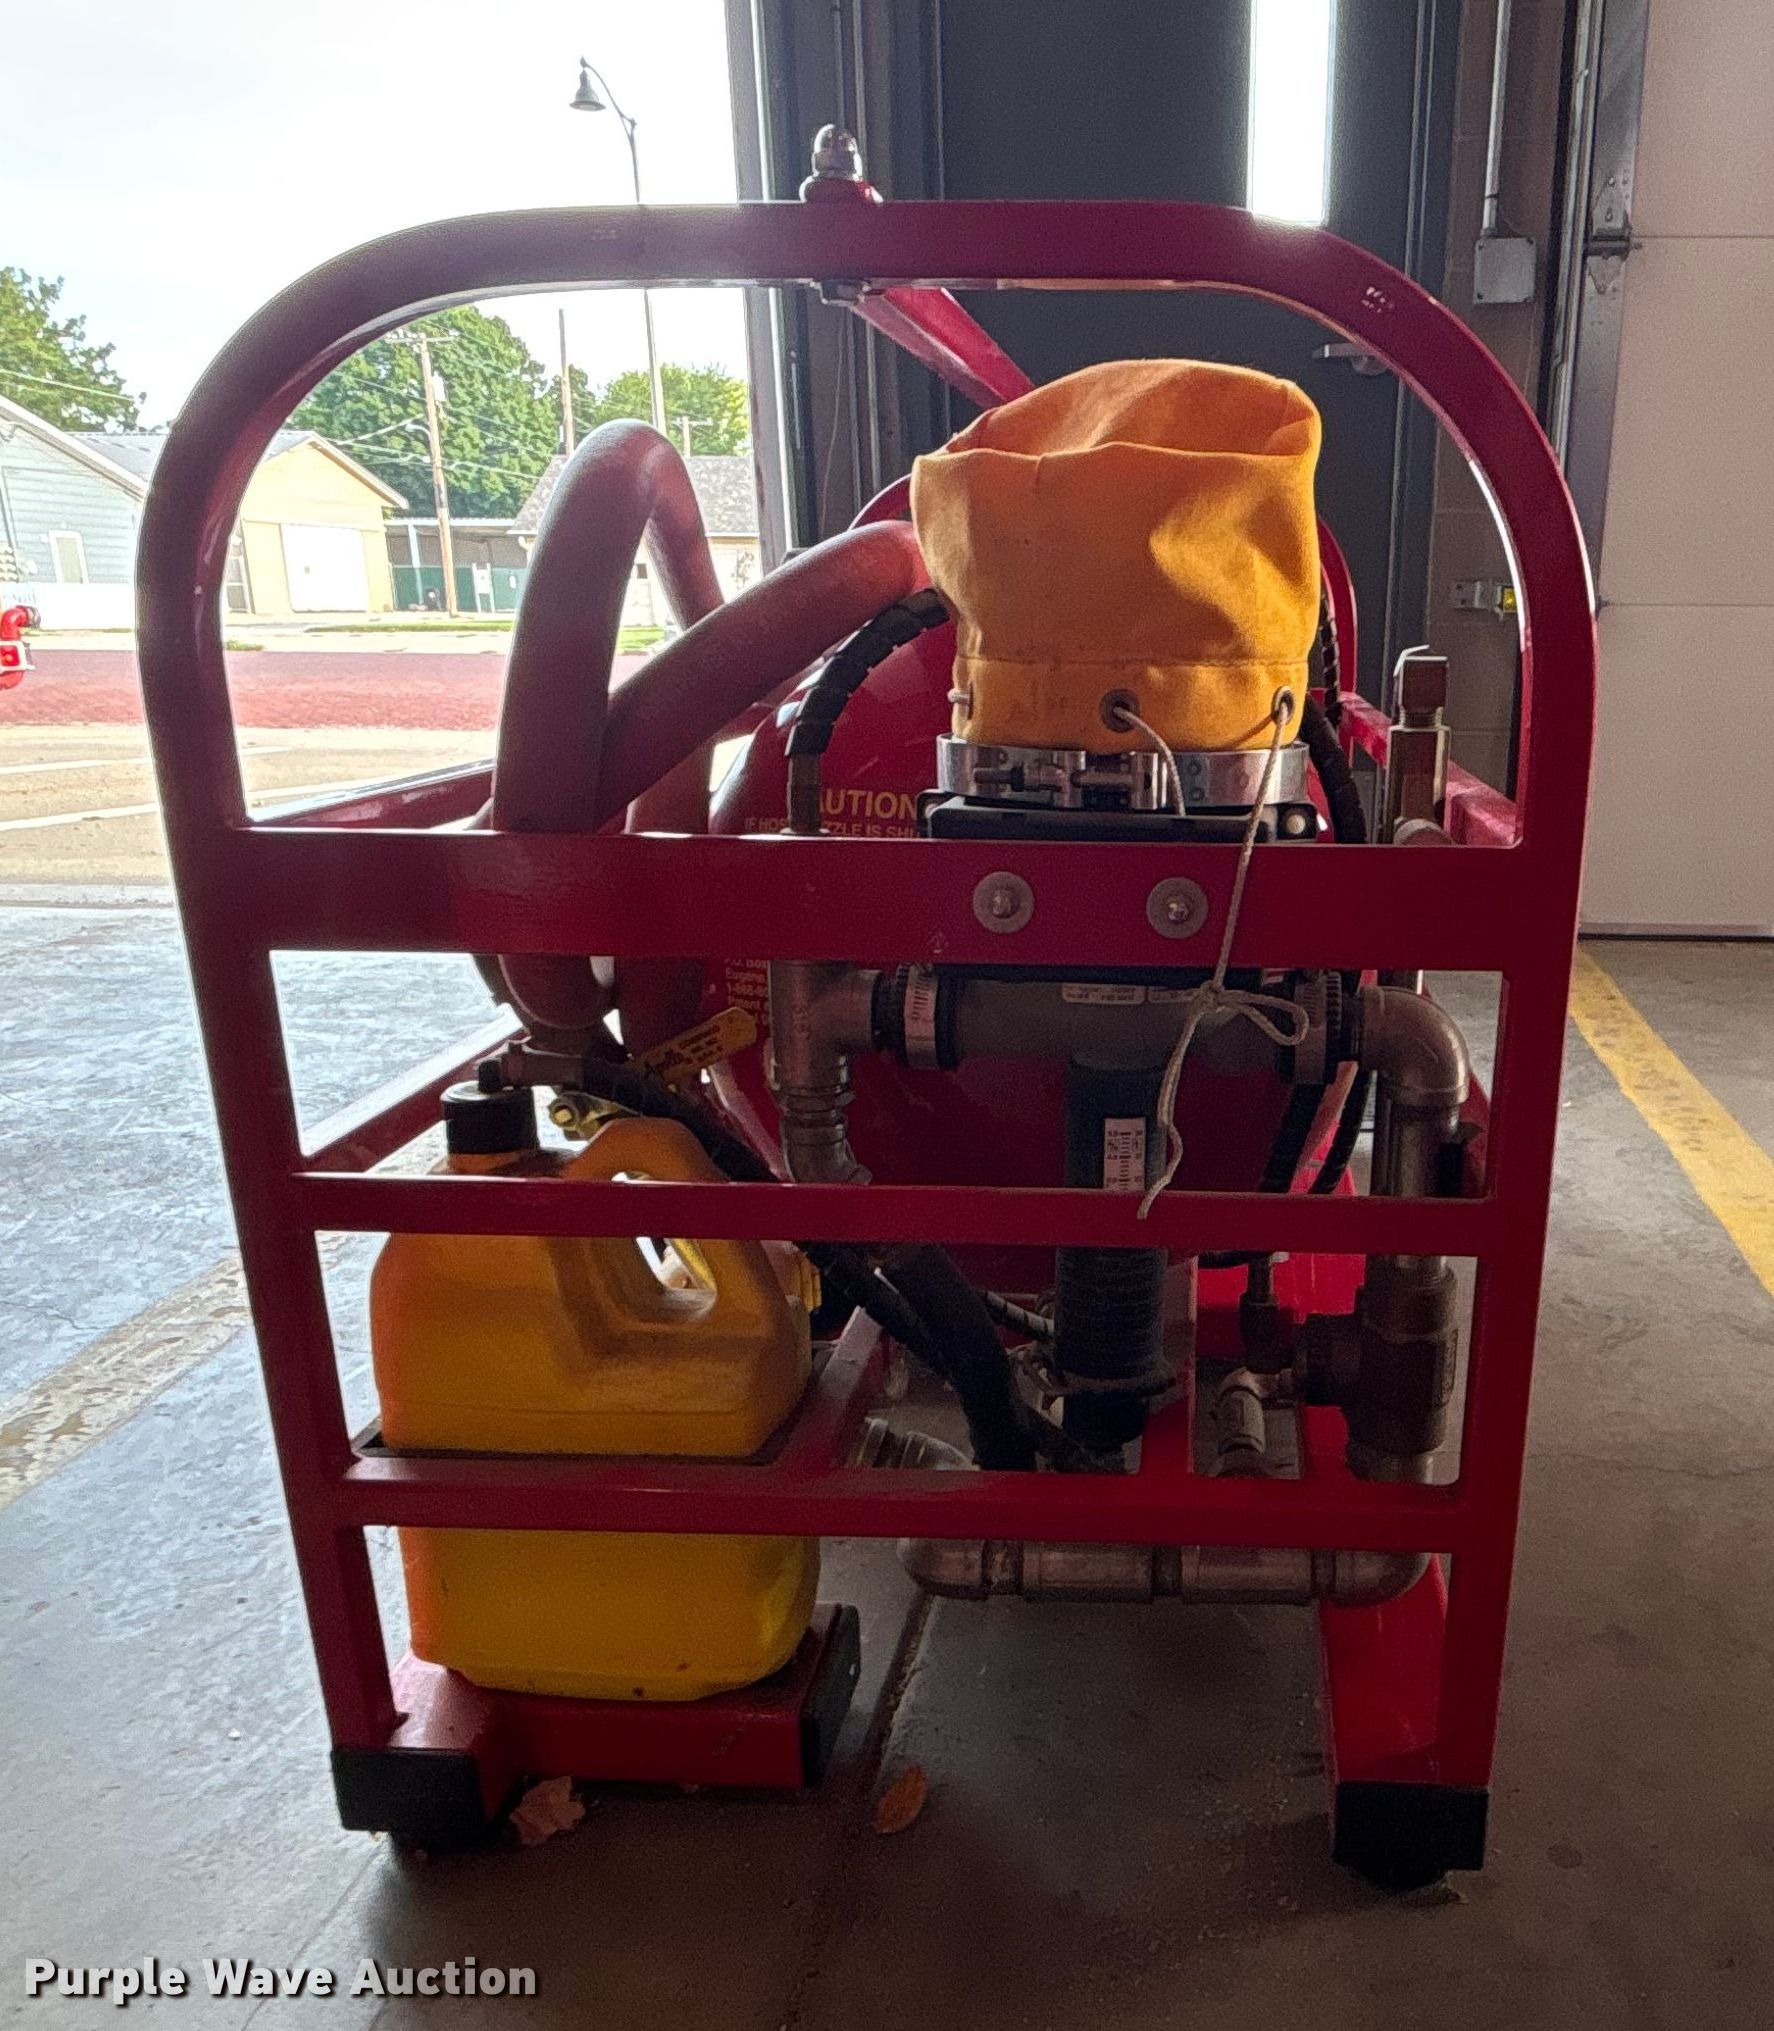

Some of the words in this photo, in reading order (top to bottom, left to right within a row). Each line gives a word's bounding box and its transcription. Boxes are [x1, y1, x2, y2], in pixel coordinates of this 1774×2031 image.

[820, 788, 916, 820] UTION
[759, 817, 788, 832] HOS
[866, 824, 882, 837] IS
